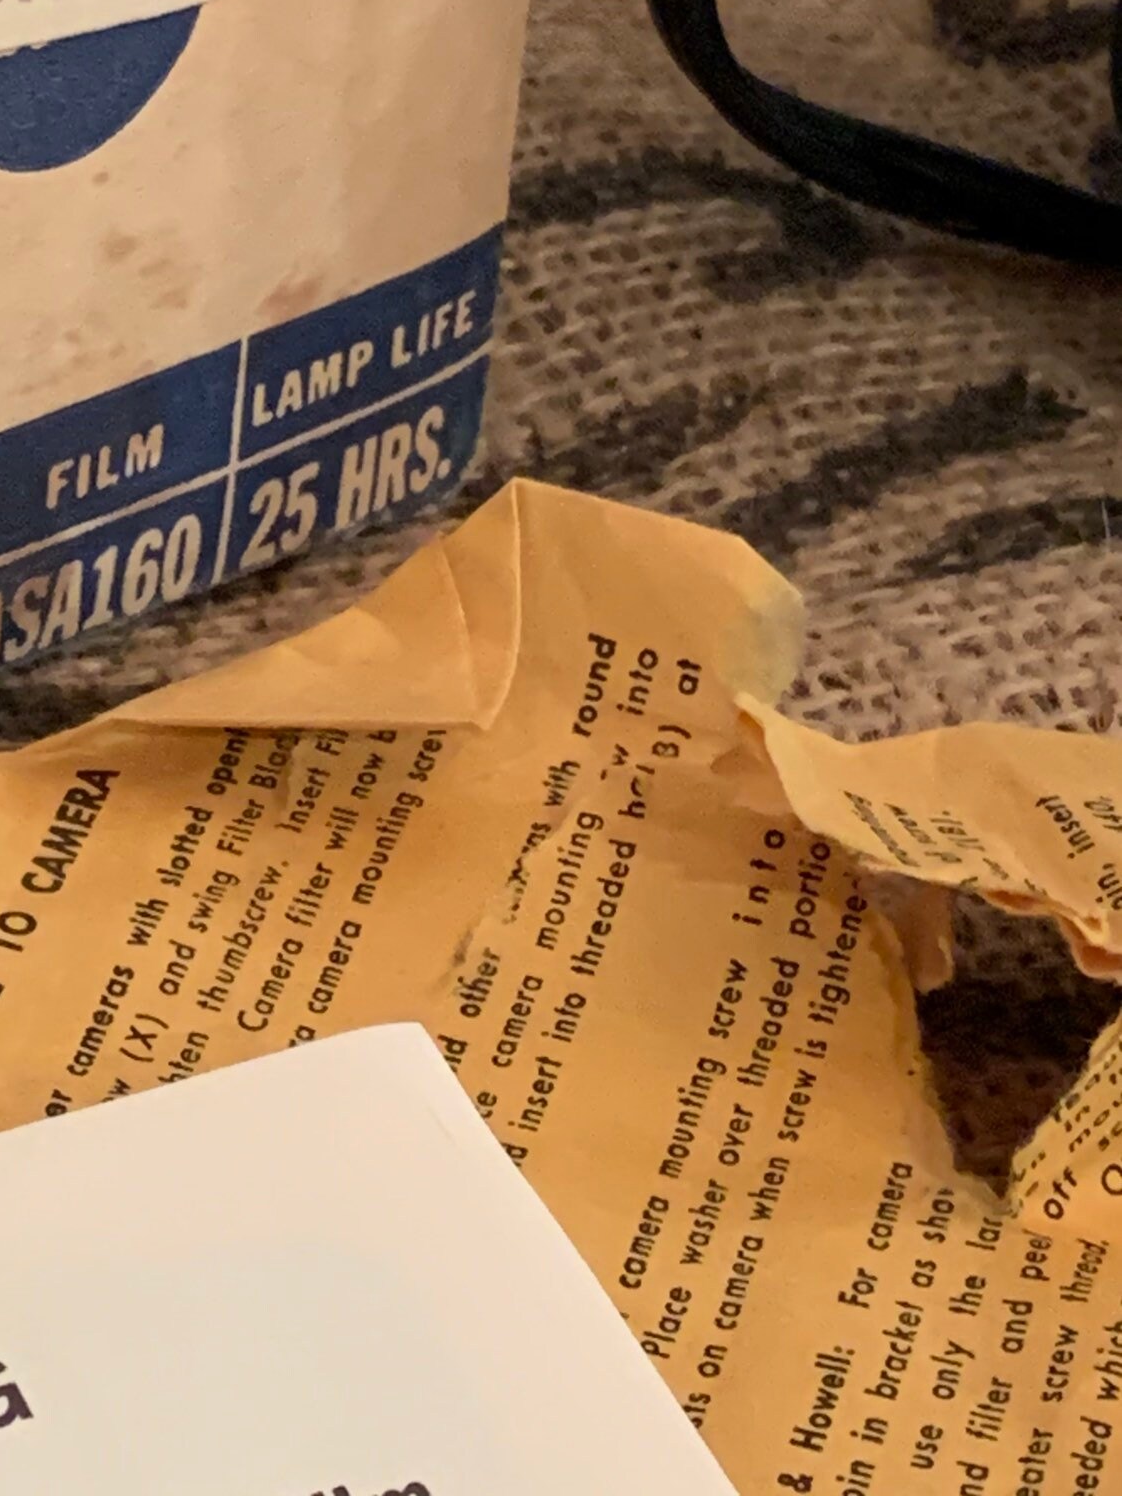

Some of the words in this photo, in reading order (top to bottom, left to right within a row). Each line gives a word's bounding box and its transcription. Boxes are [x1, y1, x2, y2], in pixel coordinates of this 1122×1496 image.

[253, 340, 374, 426] LAMP
[391, 290, 476, 366] LIFE
[47, 424, 165, 508] FILM
[241, 460, 322, 567] 25
[334, 405, 452, 523] HRS.
[20, 769, 121, 894] CAMERA
[457, 946, 502, 1019] other
[542, 758, 581, 808] with
[571, 631, 618, 739] round
[491, 974, 544, 1069] camera
[535, 810, 605, 951] mounting
[615, 647, 659, 717] into
[1035, 794, 1096, 859] insert
[119, 1012, 170, 1063] (X)
[158, 939, 197, 996] and
[188, 869, 241, 933] swing
[216, 798, 265, 856] Filter
[196, 859, 290, 1012] thumbscrew.
[274, 766, 332, 834] Insert
[236, 936, 305, 1033] Camera
[283, 861, 335, 928] filter
[325, 806, 359, 852] will
[350, 753, 386, 801] now
[307, 919, 363, 1016] camera
[351, 790, 425, 905] mounting
[506, 1054, 563, 1132] insert
[540, 991, 588, 1044] into
[569, 838, 638, 977] threaded
[675, 657, 703, 697] at
[66, 964, 135, 1077] cameras
[126, 898, 170, 948] with
[156, 805, 214, 887] slotted
[736, 955, 801, 1089] threaded
[793, 1037, 829, 1061] is
[618, 1194, 671, 1291] camera
[658, 1056, 728, 1180] mounting
[707, 958, 748, 1040] screw
[718, 1102, 755, 1168] over
[777, 1067, 818, 1144] screw
[679, 1177, 730, 1266] washer
[747, 1155, 791, 1223] when
[866, 1160, 914, 1253] camera
[714, 1234, 765, 1332] camera
[837, 1266, 879, 1310] For
[909, 1257, 938, 1290] as
[947, 1273, 988, 1318] the
[964, 1375, 1013, 1443] filter
[1000, 1298, 1034, 1356] and
[1019, 1227, 1054, 1283] peel
[1042, 1165, 1079, 1222] off
[639, 1285, 694, 1360] Place
[696, 1342, 728, 1380] on
[862, 1299, 925, 1402] bracket
[929, 1337, 977, 1401] only
[1040, 1324, 1080, 1404] screw
[788, 1344, 857, 1454] Howell:
[849, 1415, 890, 1447] in
[776, 1471, 815, 1494] &
[909, 1423, 944, 1471] use
